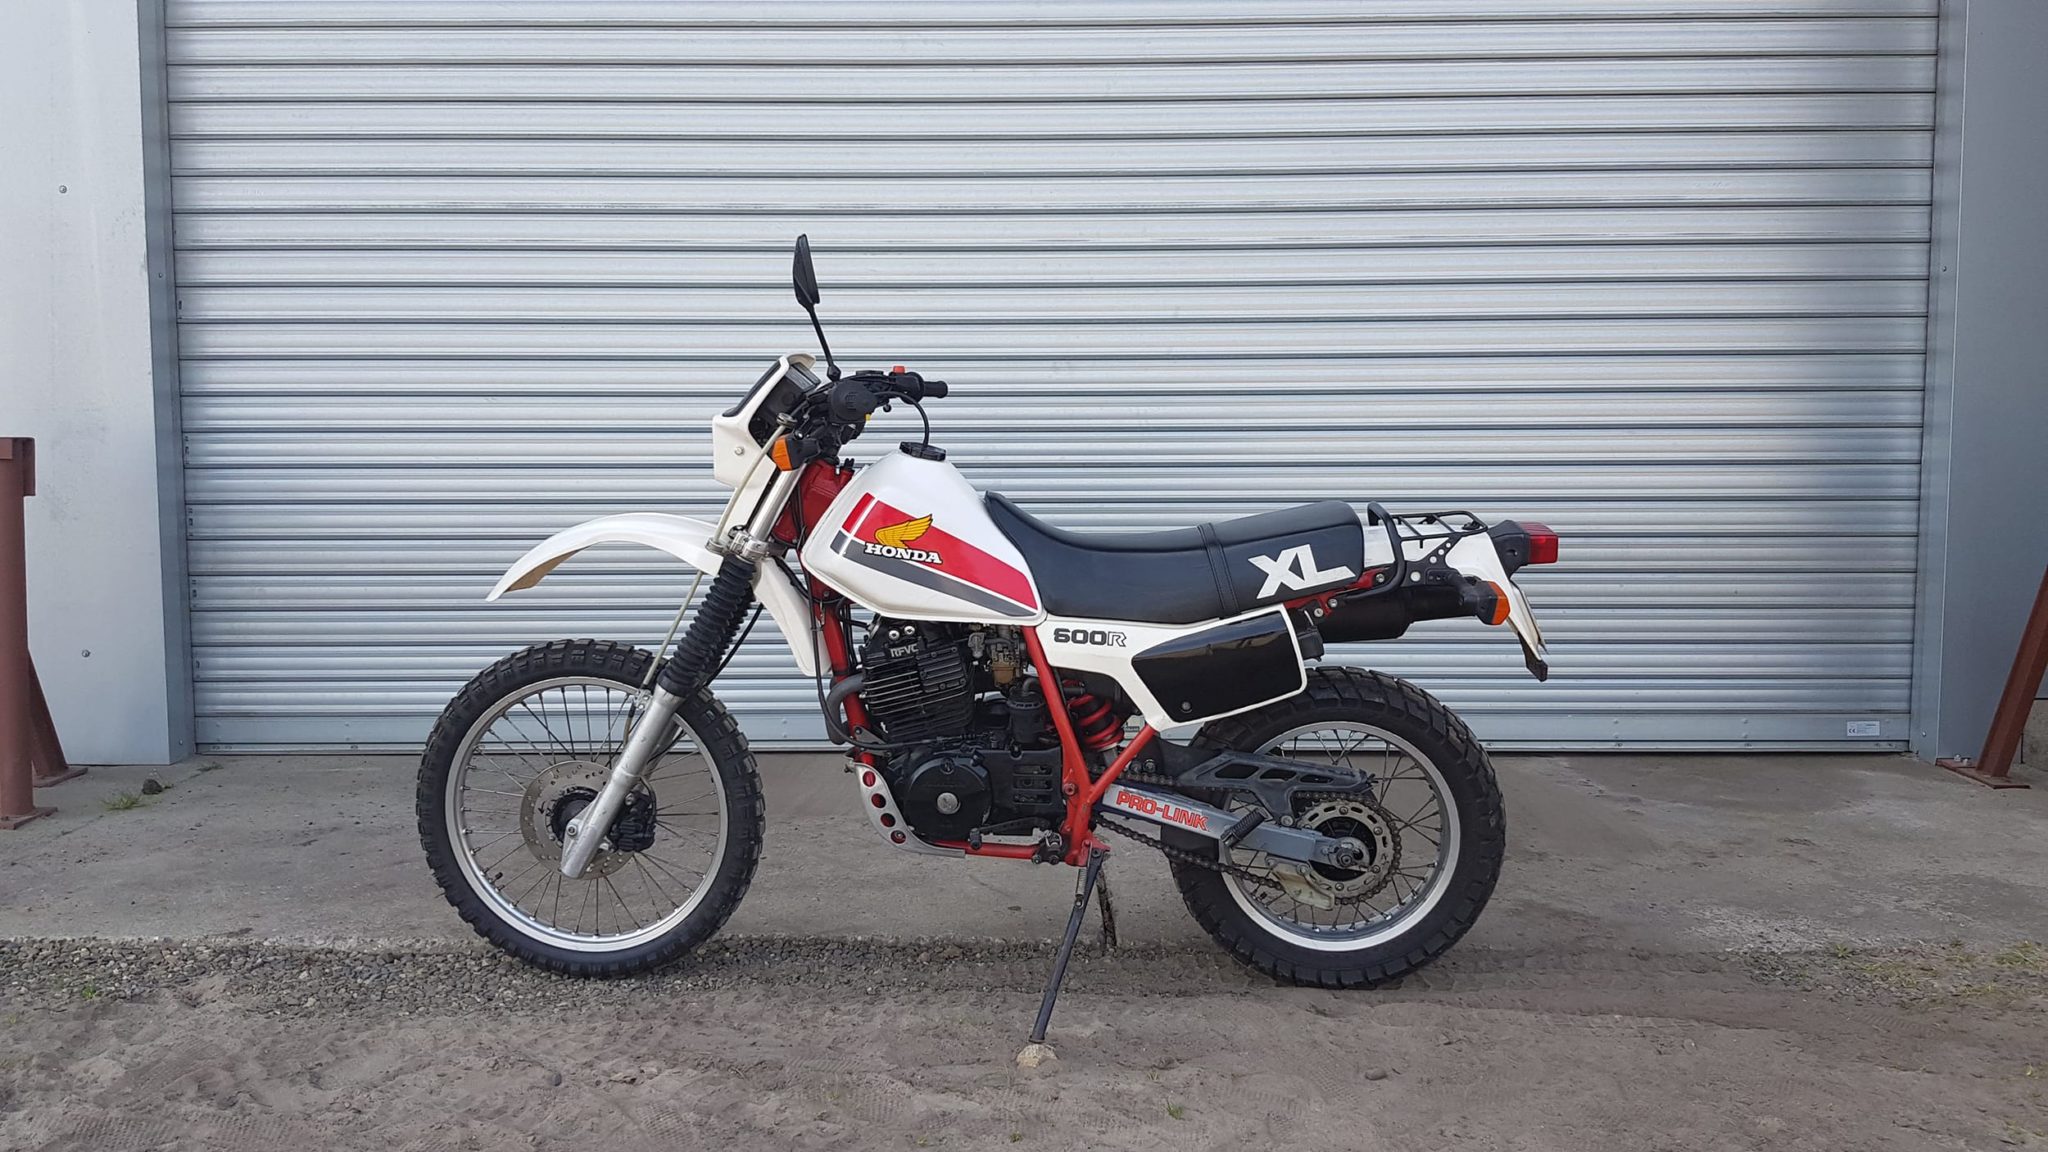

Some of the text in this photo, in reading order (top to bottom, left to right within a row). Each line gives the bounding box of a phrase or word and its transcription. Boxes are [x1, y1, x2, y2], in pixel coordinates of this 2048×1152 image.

[864, 542, 943, 564] HONDA
[1248, 544, 1356, 599] XL
[1053, 628, 1127, 647] 600R
[889, 643, 919, 657] RFVC
[1116, 790, 1210, 832] PRO-LINK
